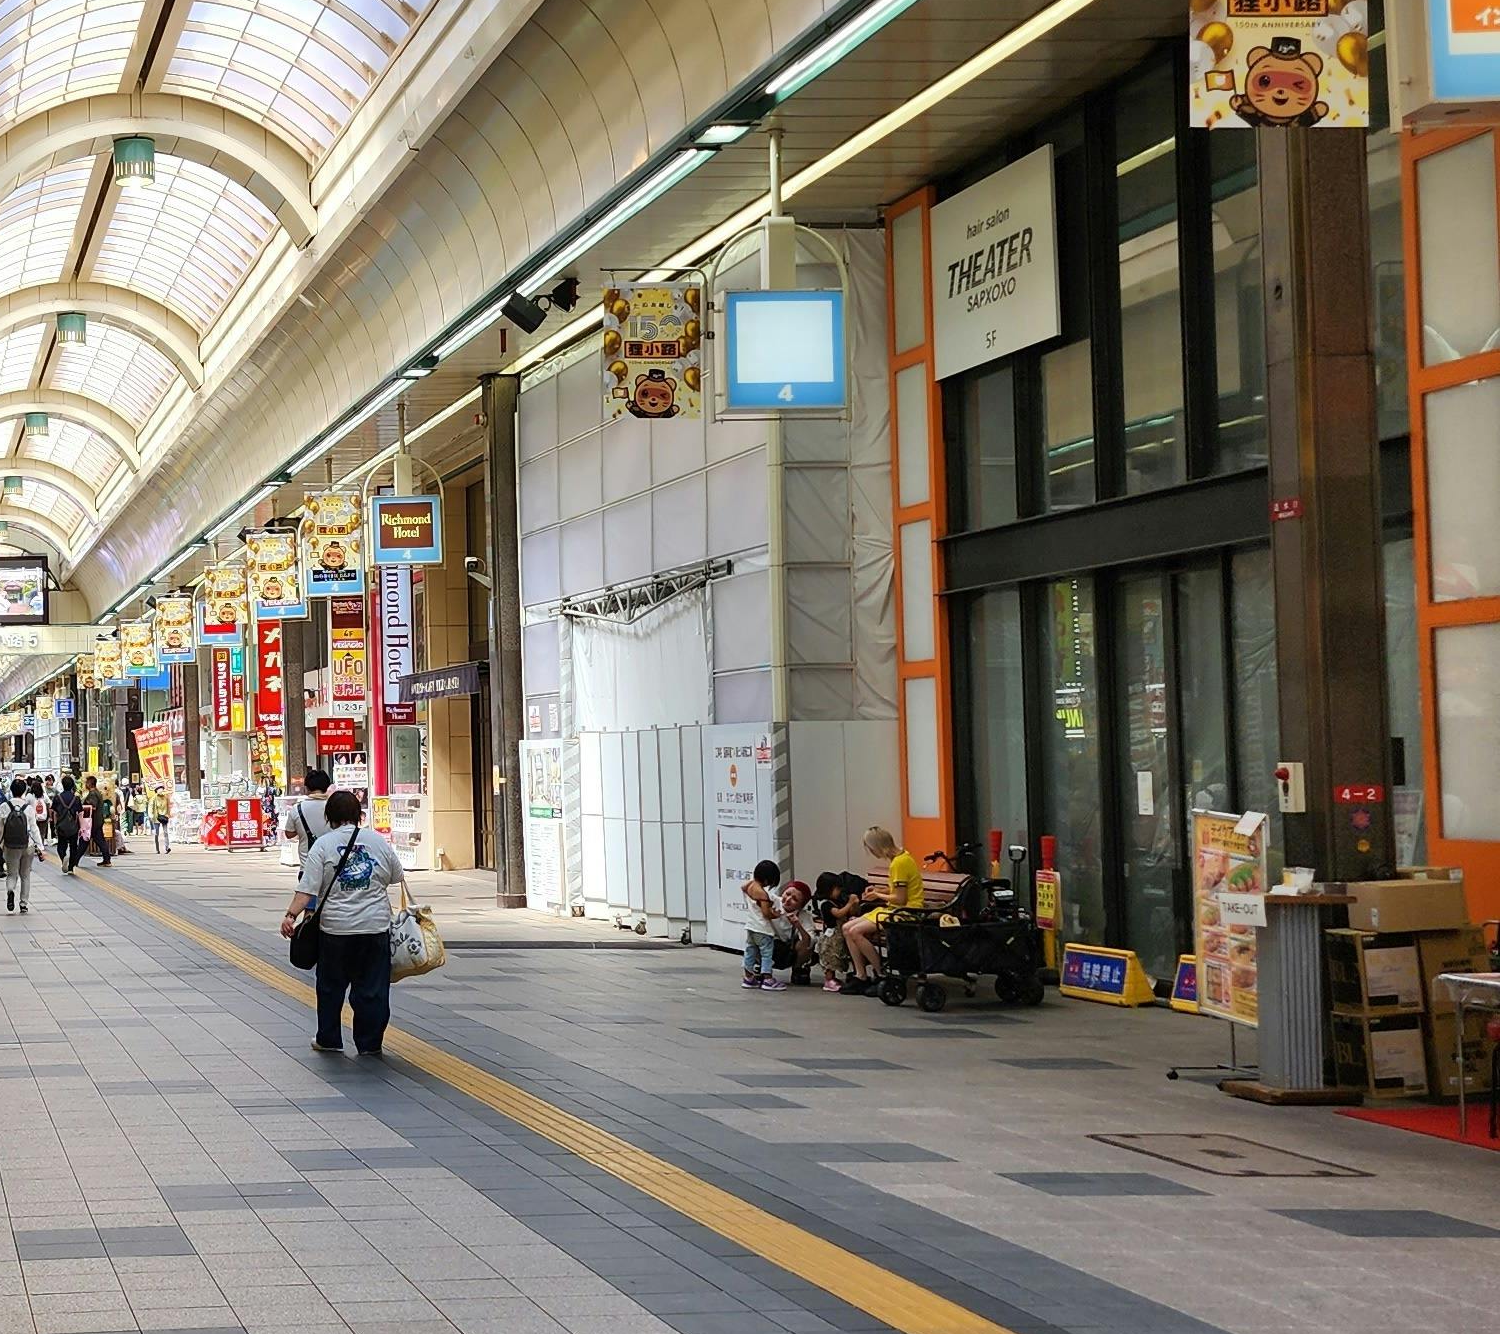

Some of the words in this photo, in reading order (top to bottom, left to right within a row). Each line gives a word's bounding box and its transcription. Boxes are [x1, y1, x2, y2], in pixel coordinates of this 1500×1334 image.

[966, 218, 985, 240] hair
[985, 207, 1010, 231] salon
[947, 226, 1034, 300] THEATER
[626, 342, 678, 357] 狸小路
[777, 383, 795, 402] 4
[380, 512, 432, 526] Richmond
[392, 526, 421, 539] Hotel
[402, 549, 412, 560] 4
[384, 564, 410, 629] mond
[28, 633, 38, 647] 5
[333, 658, 364, 677] UFO
[385, 633, 410, 689] Hotel
[333, 683, 365, 698] 専門店
[1221, 901, 1259, 914] TAKE-OUT
